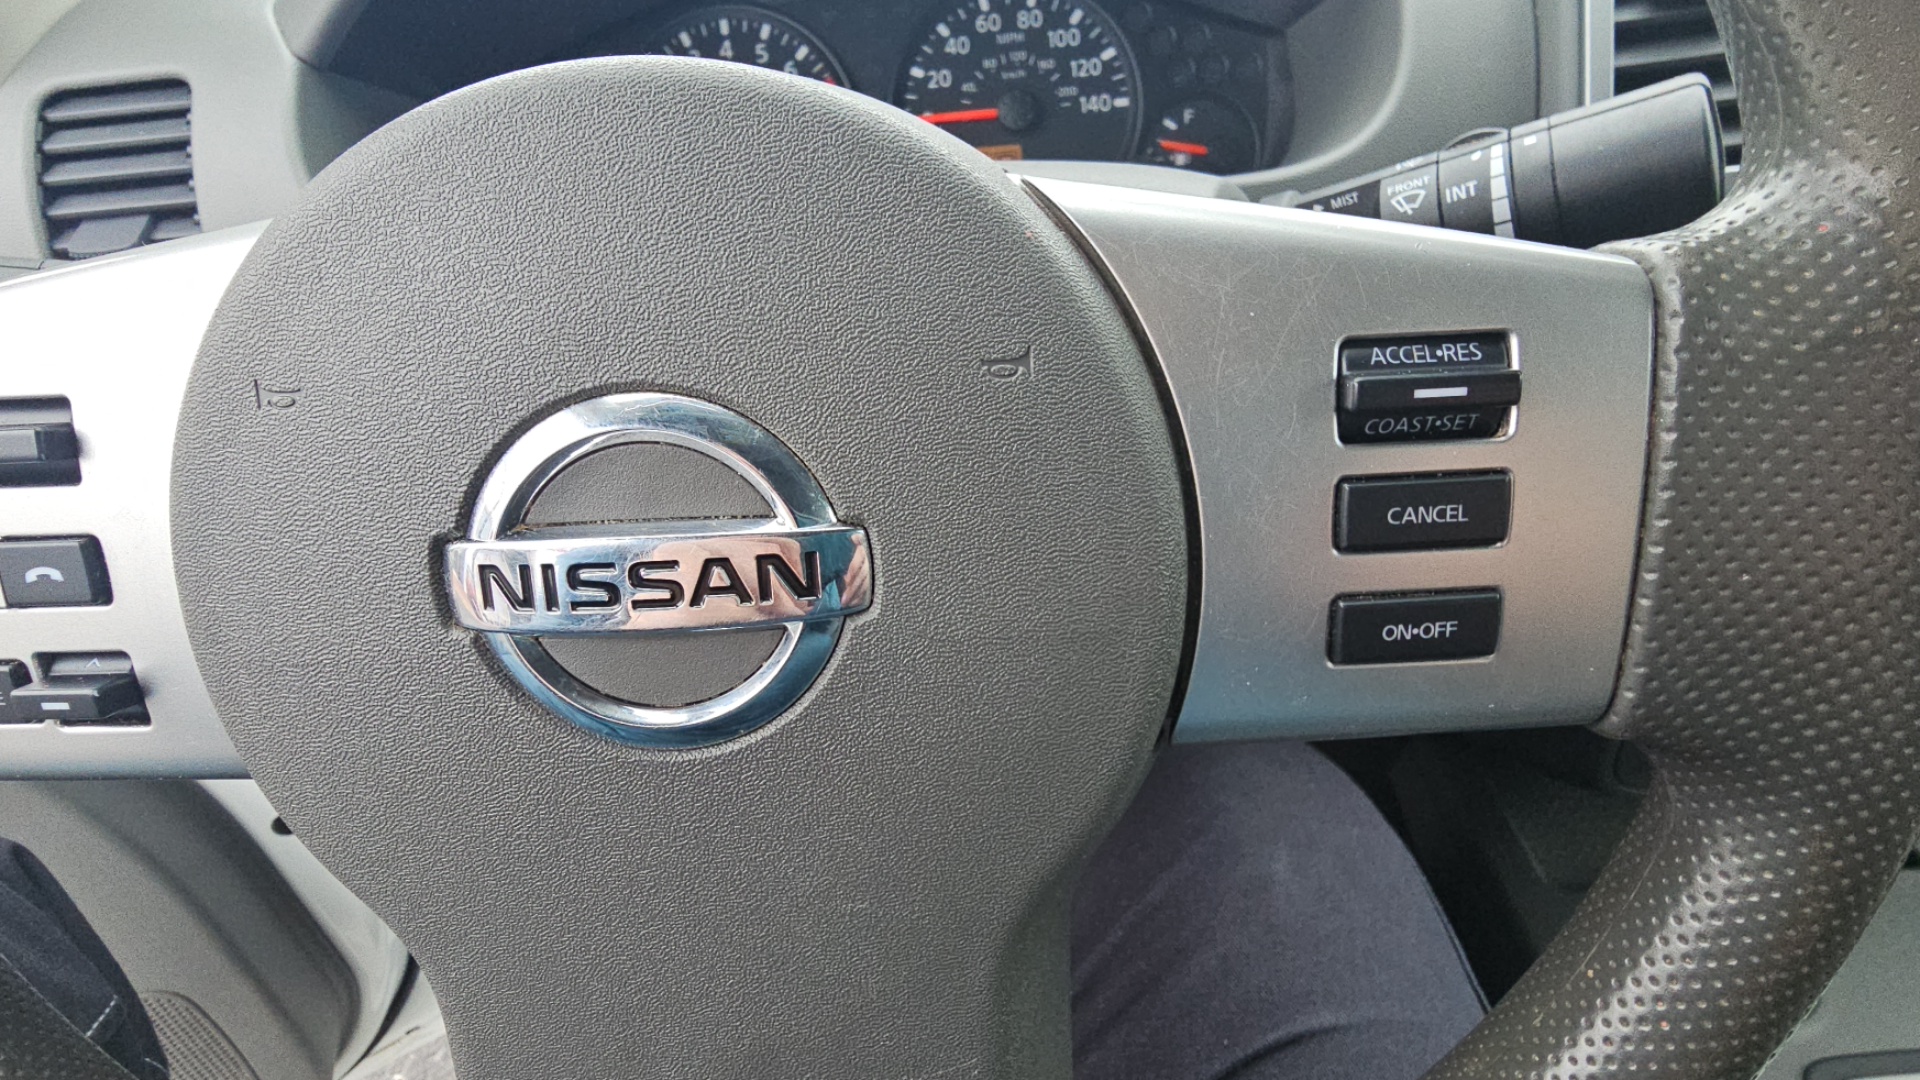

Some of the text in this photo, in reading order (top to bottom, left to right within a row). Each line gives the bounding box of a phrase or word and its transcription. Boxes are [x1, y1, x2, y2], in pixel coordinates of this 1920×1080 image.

[975, 13, 1002, 33] 60
[1016, 9, 1043, 28] 80
[944, 35, 970, 56] 40
[1047, 28, 1081, 48] 100
[719, 39, 733, 60] 4
[755, 43, 769, 64] 5
[1070, 57, 1102, 78] 120
[927, 69, 952, 89] 20
[1079, 93, 1112, 114] 140
[1183, 108, 1195, 124] F
[1387, 176, 1431, 196] FRONT
[1445, 180, 1478, 203] INT
[1330, 192, 1359, 210] MIST
[1387, 504, 1469, 525] CANCEL
[477, 550, 823, 613] NISSAN
